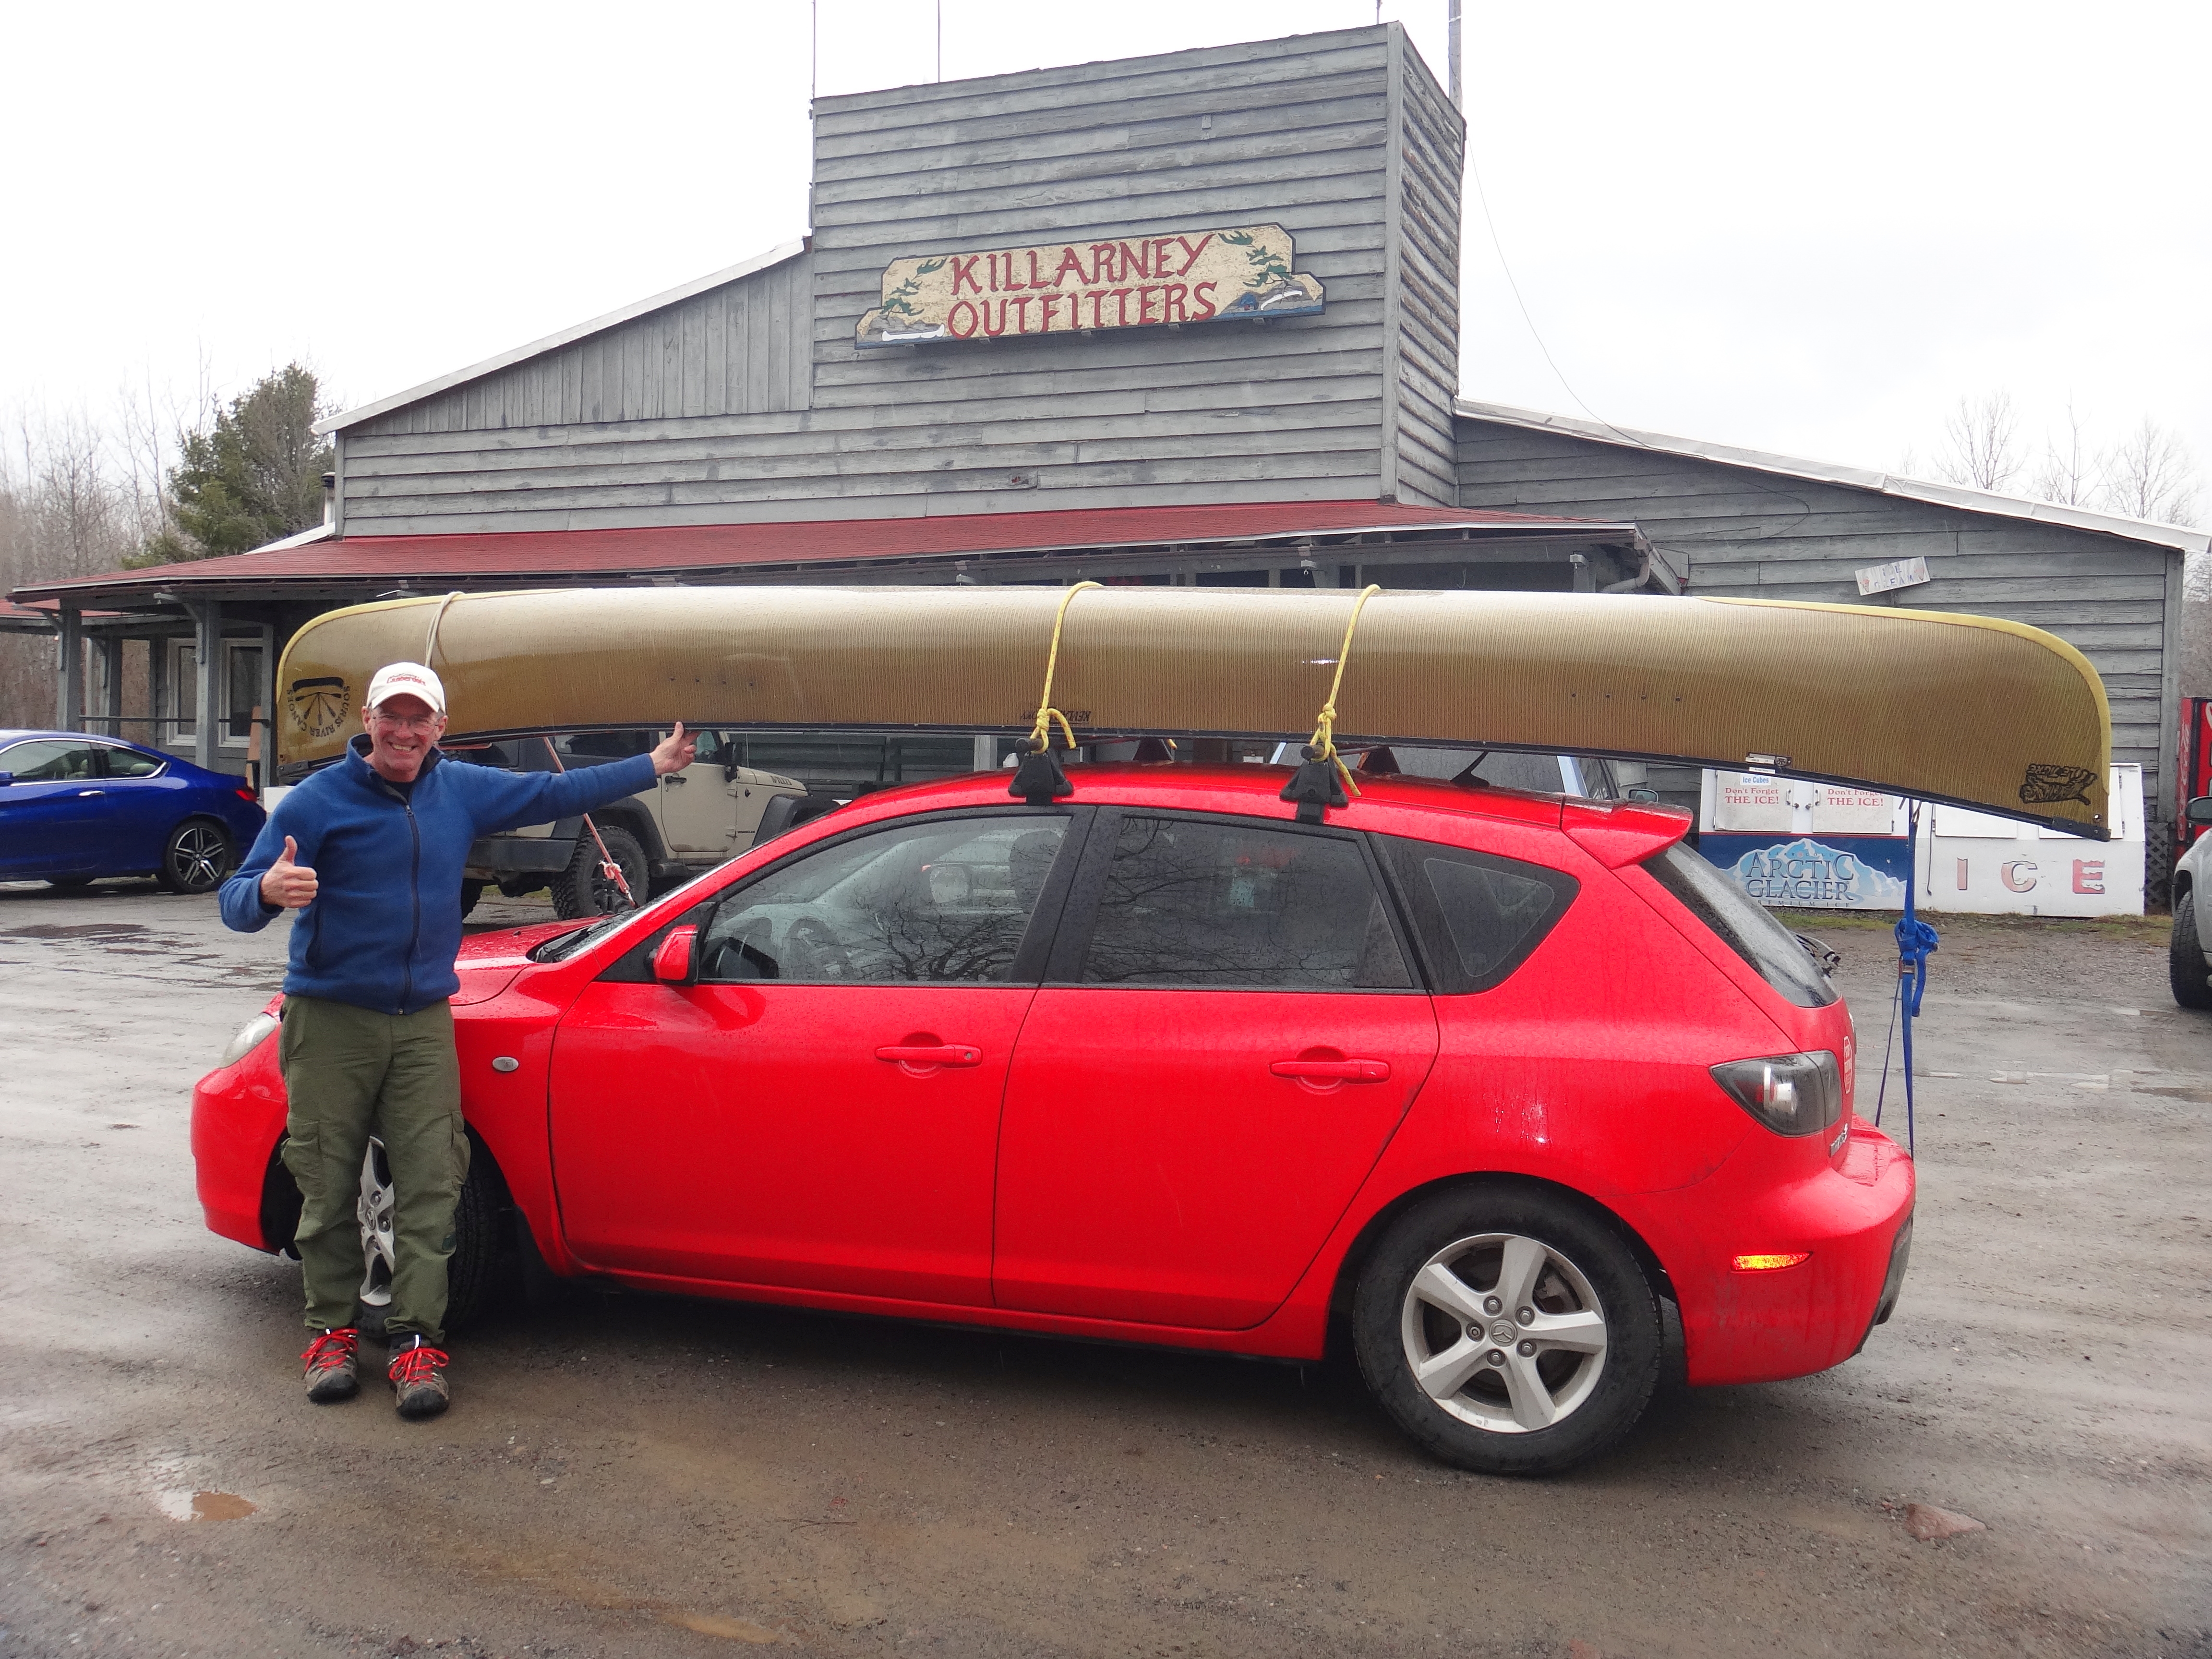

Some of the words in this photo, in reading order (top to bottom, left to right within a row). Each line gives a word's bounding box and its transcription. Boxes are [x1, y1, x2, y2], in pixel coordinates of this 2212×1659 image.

[950, 234, 1215, 295] KILLARNEY
[948, 281, 1217, 339] OUTFITTERS
[1874, 575, 1914, 588] CEAM
[309, 724, 335, 737] RIVER
[1858, 798, 1884, 806] ICE!
[1746, 852, 1854, 880] ARCTIC
[1957, 857, 2105, 894] ICE
[1746, 879, 1854, 901] GLACIER
